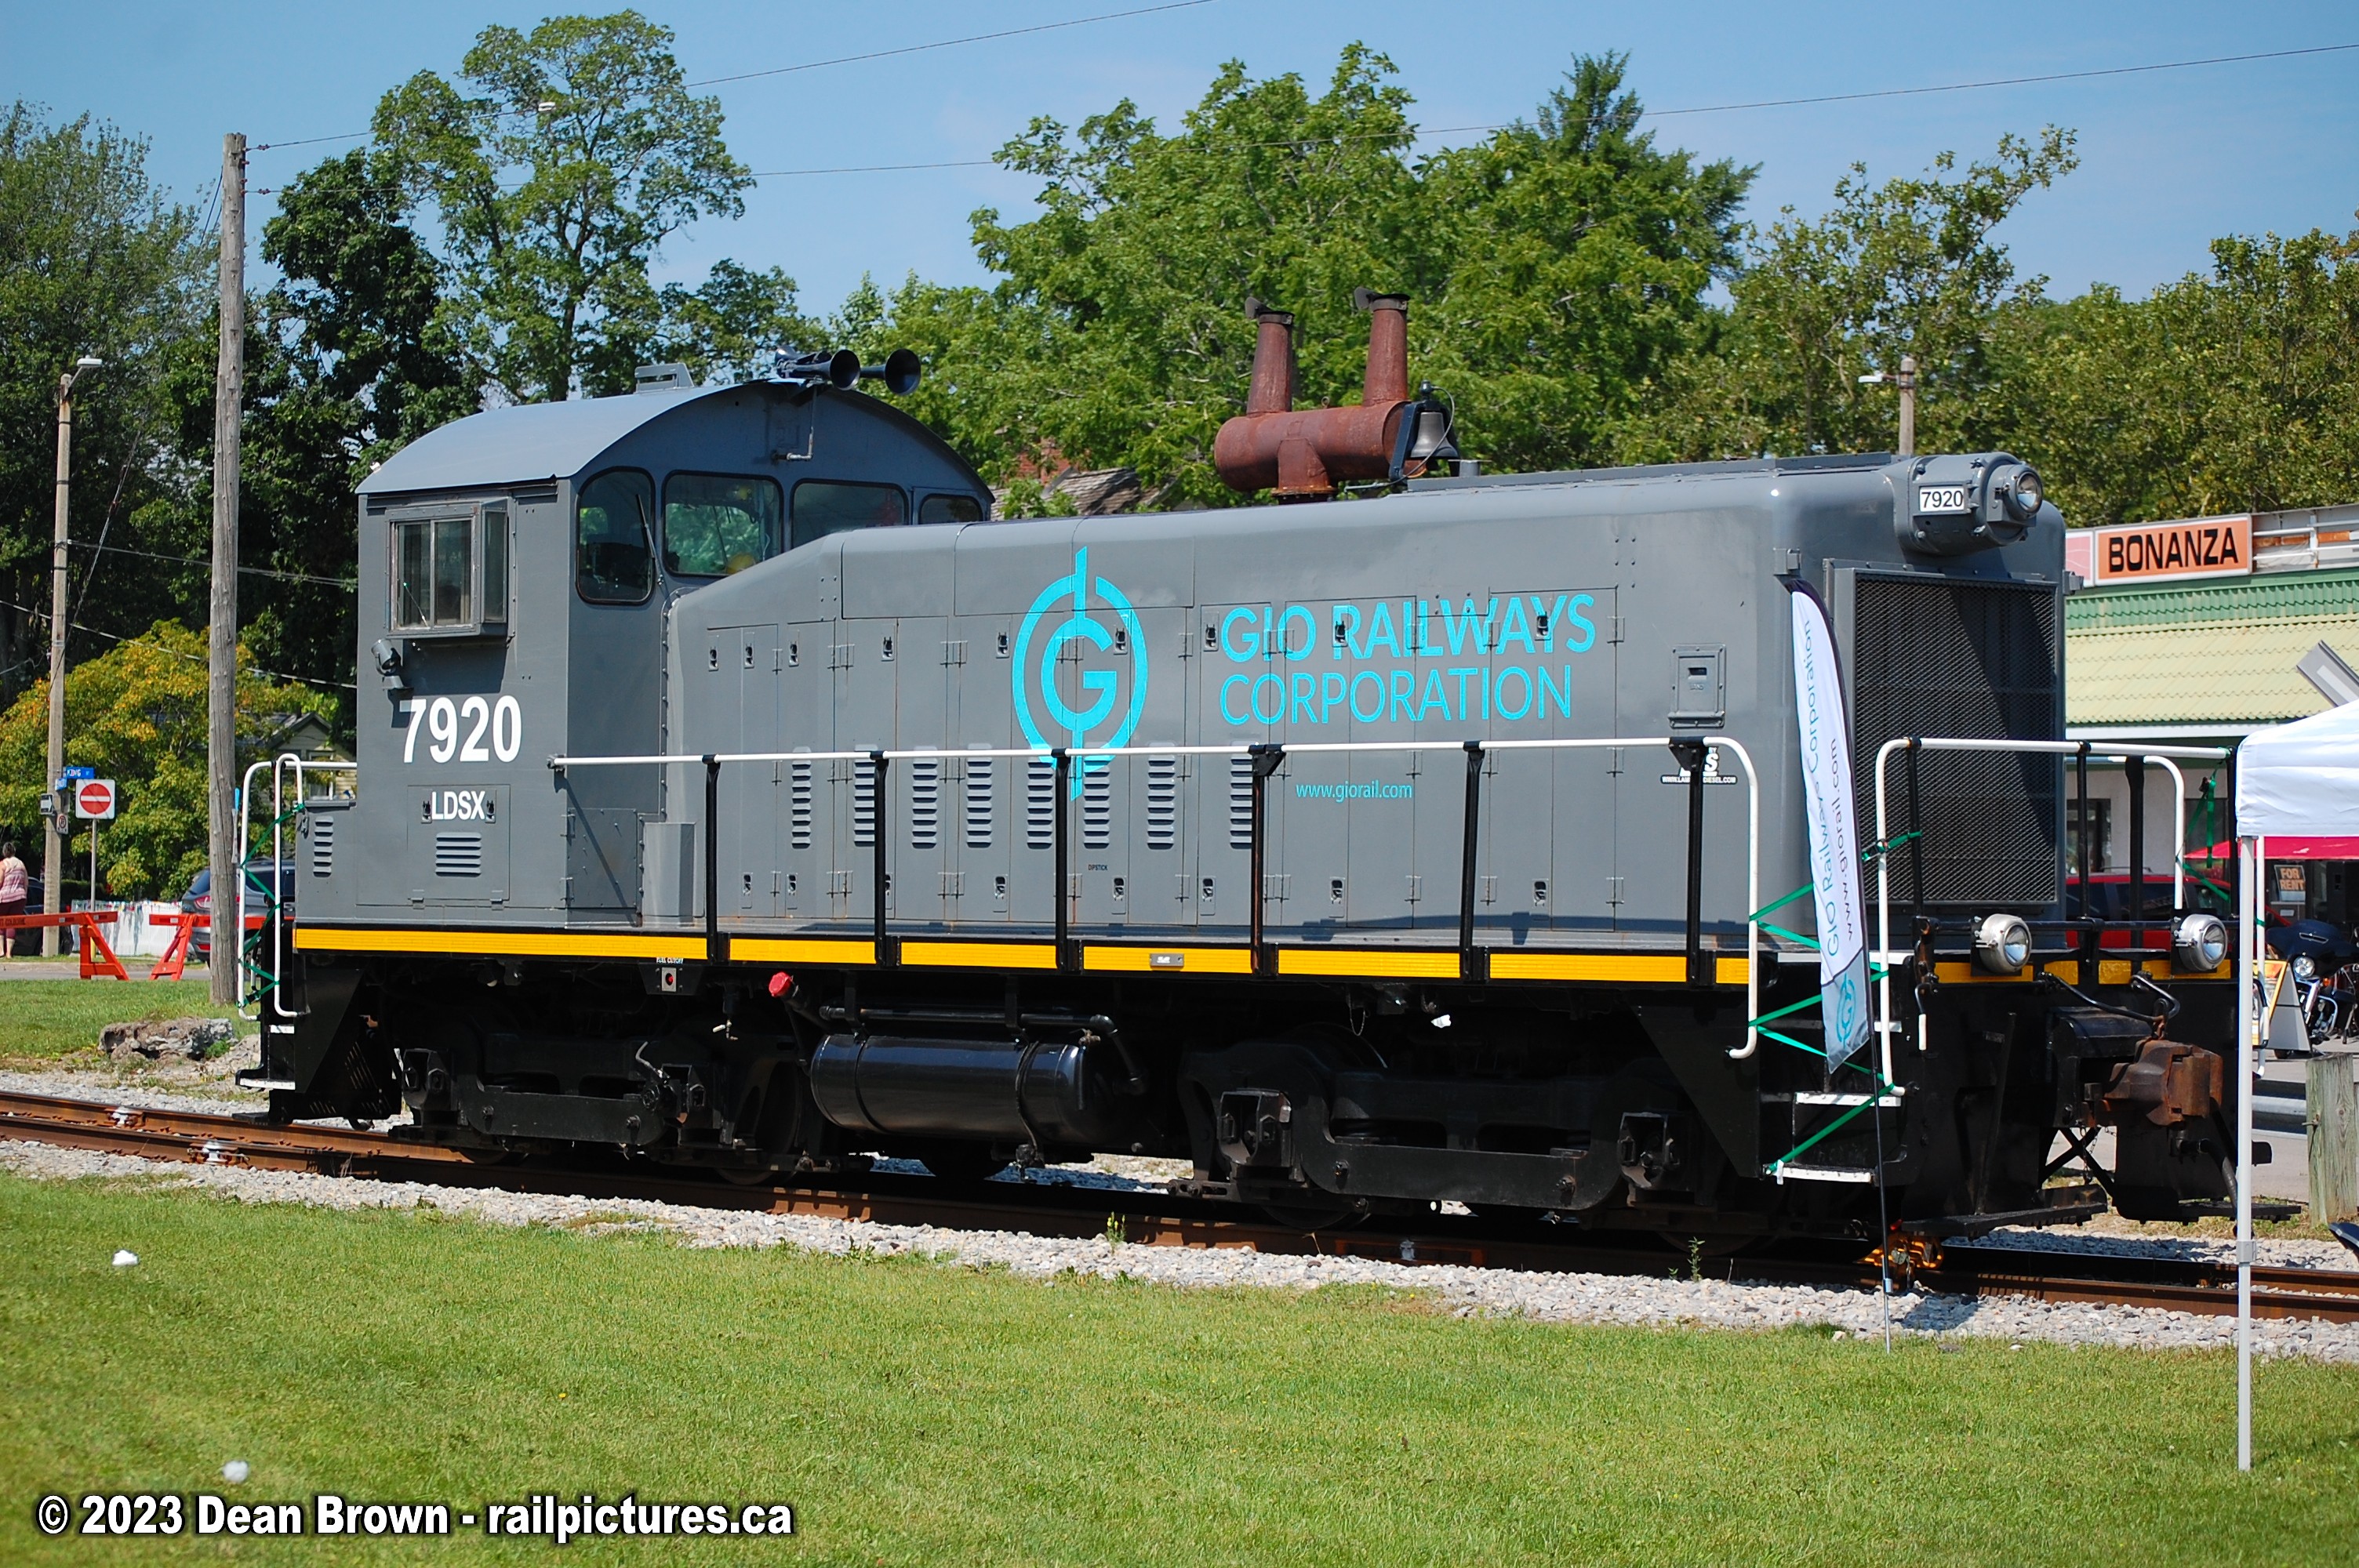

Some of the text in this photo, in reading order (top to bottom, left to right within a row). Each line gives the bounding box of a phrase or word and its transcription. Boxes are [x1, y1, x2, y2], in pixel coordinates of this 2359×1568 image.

[1921, 490, 1964, 508] 7920
[2109, 527, 2239, 573] BONANZA
[1221, 593, 1595, 663] GIO RAILWAYS
[1219, 664, 1571, 725] CORPORATION
[1804, 620, 1819, 773] Corporation
[399, 695, 522, 763] 7920
[432, 790, 485, 820] LDSX
[1296, 779, 1412, 803] www.giorail.com
[1830, 739, 1853, 941] www.giorail.com
[2279, 879, 2305, 891] RENT
[2280, 868, 2299, 879] FOR
[1826, 901, 1839, 956] GIO
